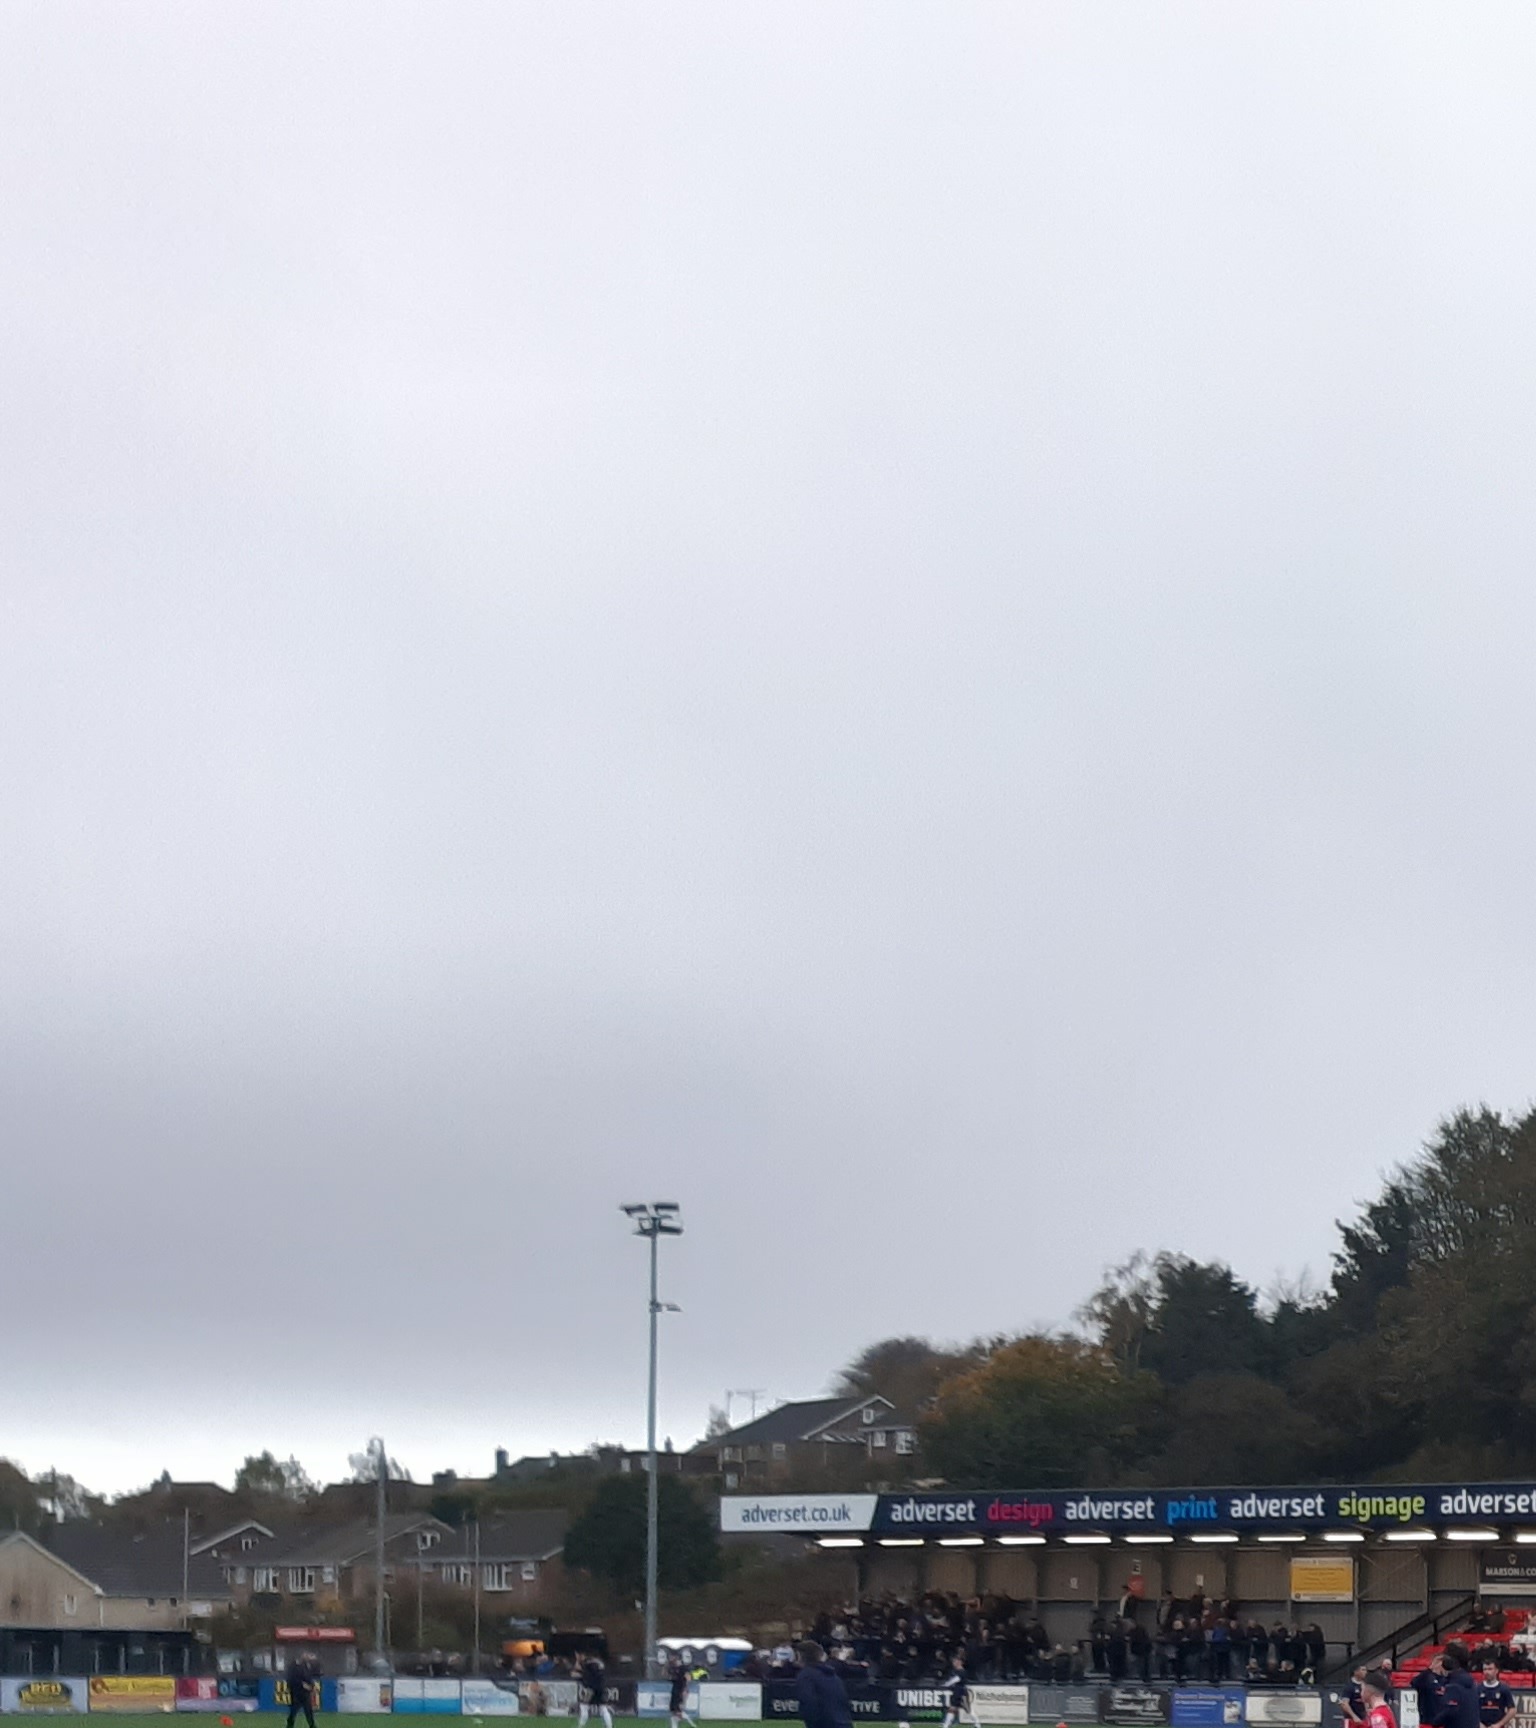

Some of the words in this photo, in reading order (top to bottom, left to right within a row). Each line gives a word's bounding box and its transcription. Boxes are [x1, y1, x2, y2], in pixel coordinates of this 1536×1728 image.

[741, 1504, 851, 1524] adverset.co.uk
[891, 1498, 976, 1523] adverset
[987, 1498, 1054, 1527] design
[1065, 1495, 1155, 1520] adverset
[1167, 1494, 1218, 1524] print
[1230, 1493, 1325, 1518] adverset
[1338, 1491, 1425, 1522] signage
[896, 1689, 954, 1708] UNIBET
